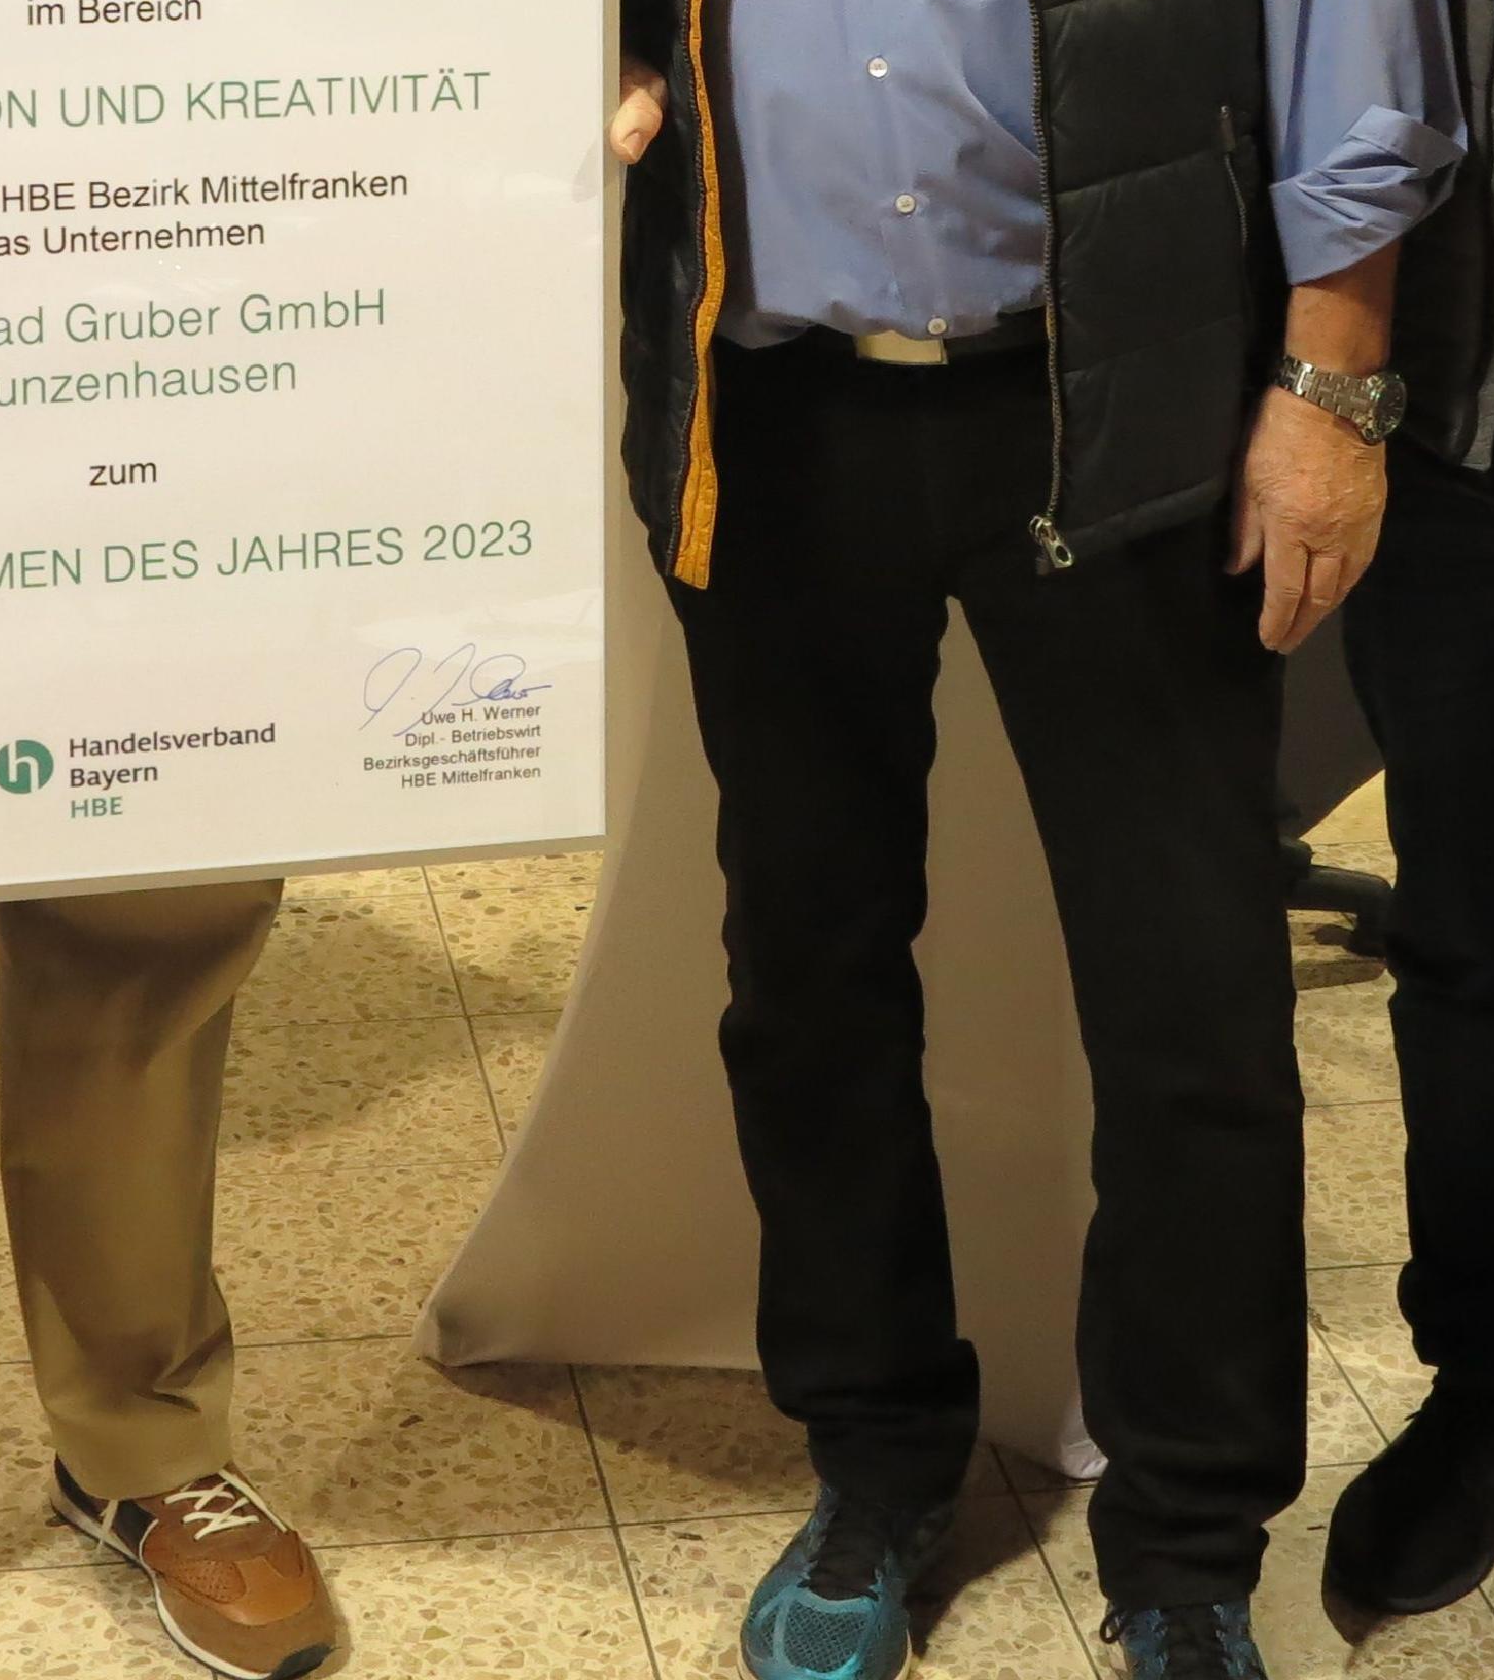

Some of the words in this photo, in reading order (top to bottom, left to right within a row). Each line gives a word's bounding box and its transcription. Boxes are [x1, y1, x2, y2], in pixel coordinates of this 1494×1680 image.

[61, 84, 164, 127] UND
[187, 68, 490, 120] KREATIVITÄT
[2, 182, 76, 213] HBE
[89, 178, 190, 209] Bezirk
[201, 171, 407, 204] Mittelfranken
[43, 221, 264, 254] Unternehmen
[66, 301, 220, 342] Gruber
[240, 289, 383, 334] GmbH
[89, 462, 157, 486] zum
[105, 540, 199, 583] DES
[217, 527, 403, 575] JAHRES
[424, 520, 531, 561] 2023
[422, 711, 454, 725] Uwe
[483, 706, 541, 720] Werner
[70, 723, 275, 758] Handelsverband
[452, 725, 540, 743] Betriebswirt
[364, 746, 540, 770] Bezirksgeschäftsführer
[70, 766, 158, 791] Bayern
[402, 772, 436, 788] HBE
[442, 767, 540, 784] Mittelfranken
[71, 796, 122, 818] HBE
